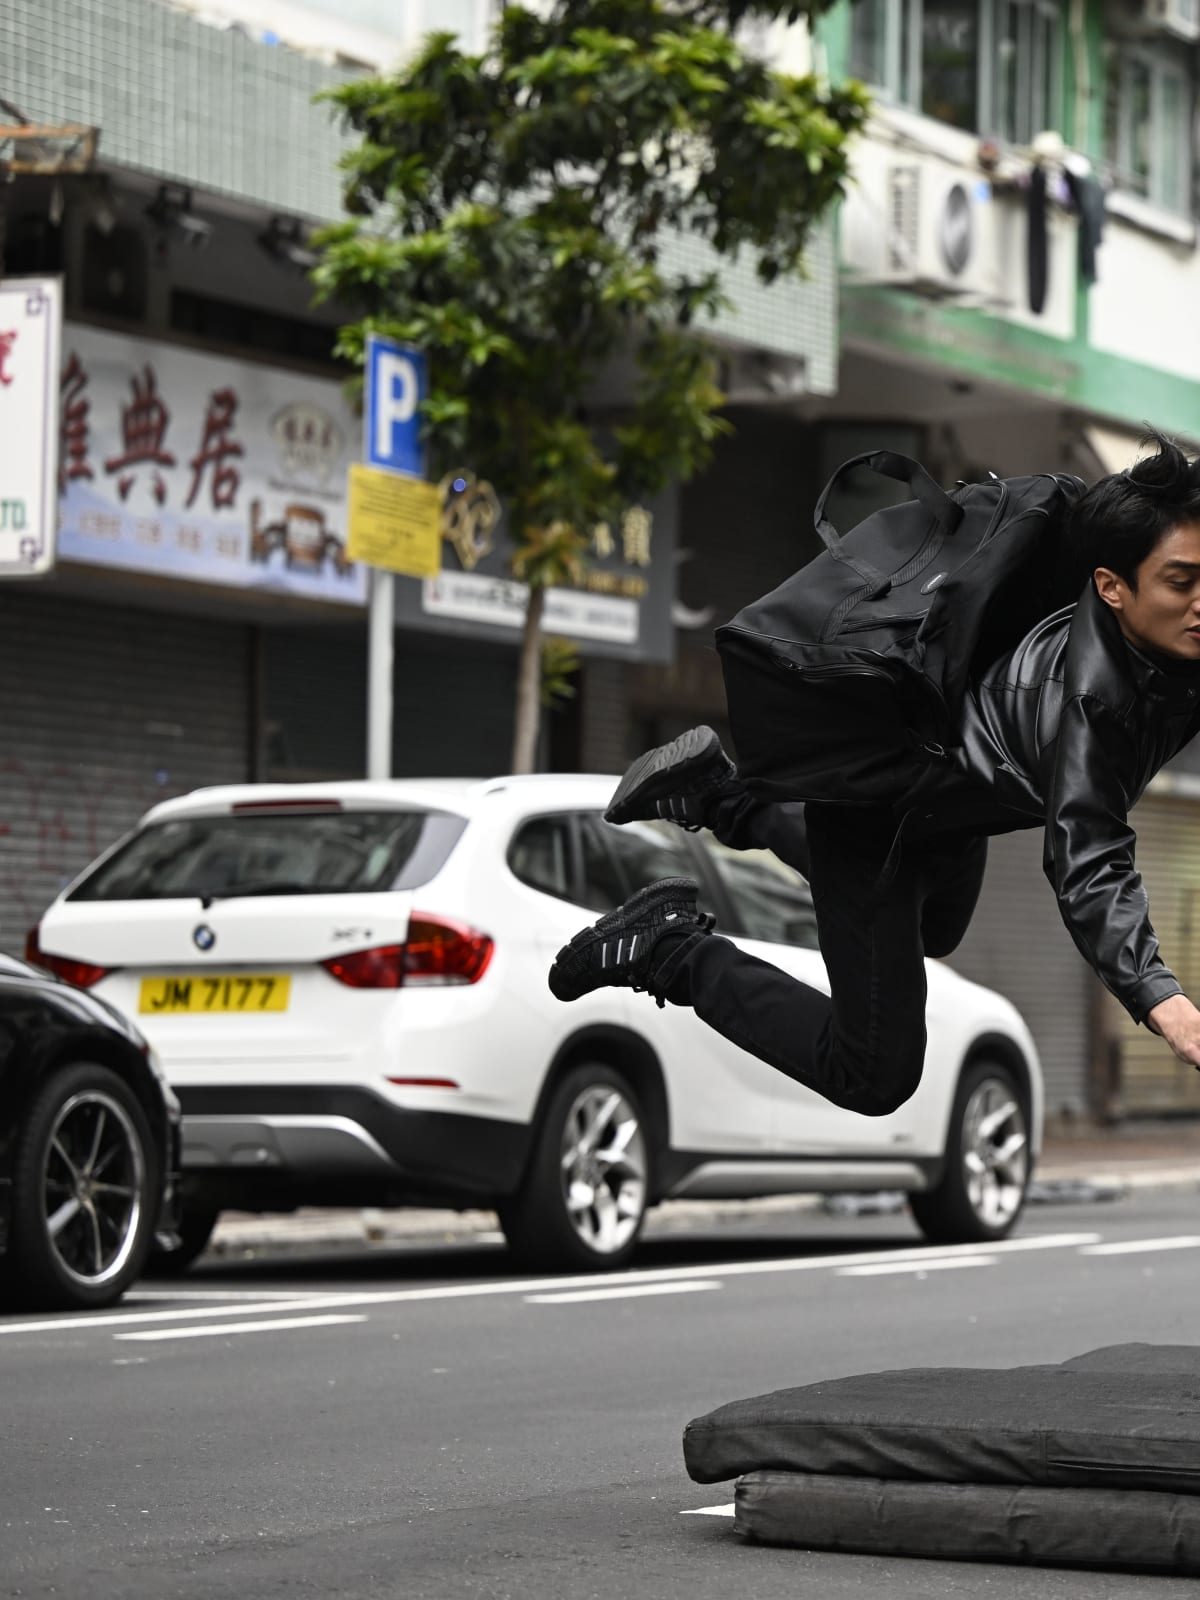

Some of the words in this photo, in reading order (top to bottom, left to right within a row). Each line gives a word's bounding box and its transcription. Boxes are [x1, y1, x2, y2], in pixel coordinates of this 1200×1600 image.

[376, 351, 418, 459] P
[151, 977, 192, 1009] JM
[202, 976, 275, 1009] 7177
